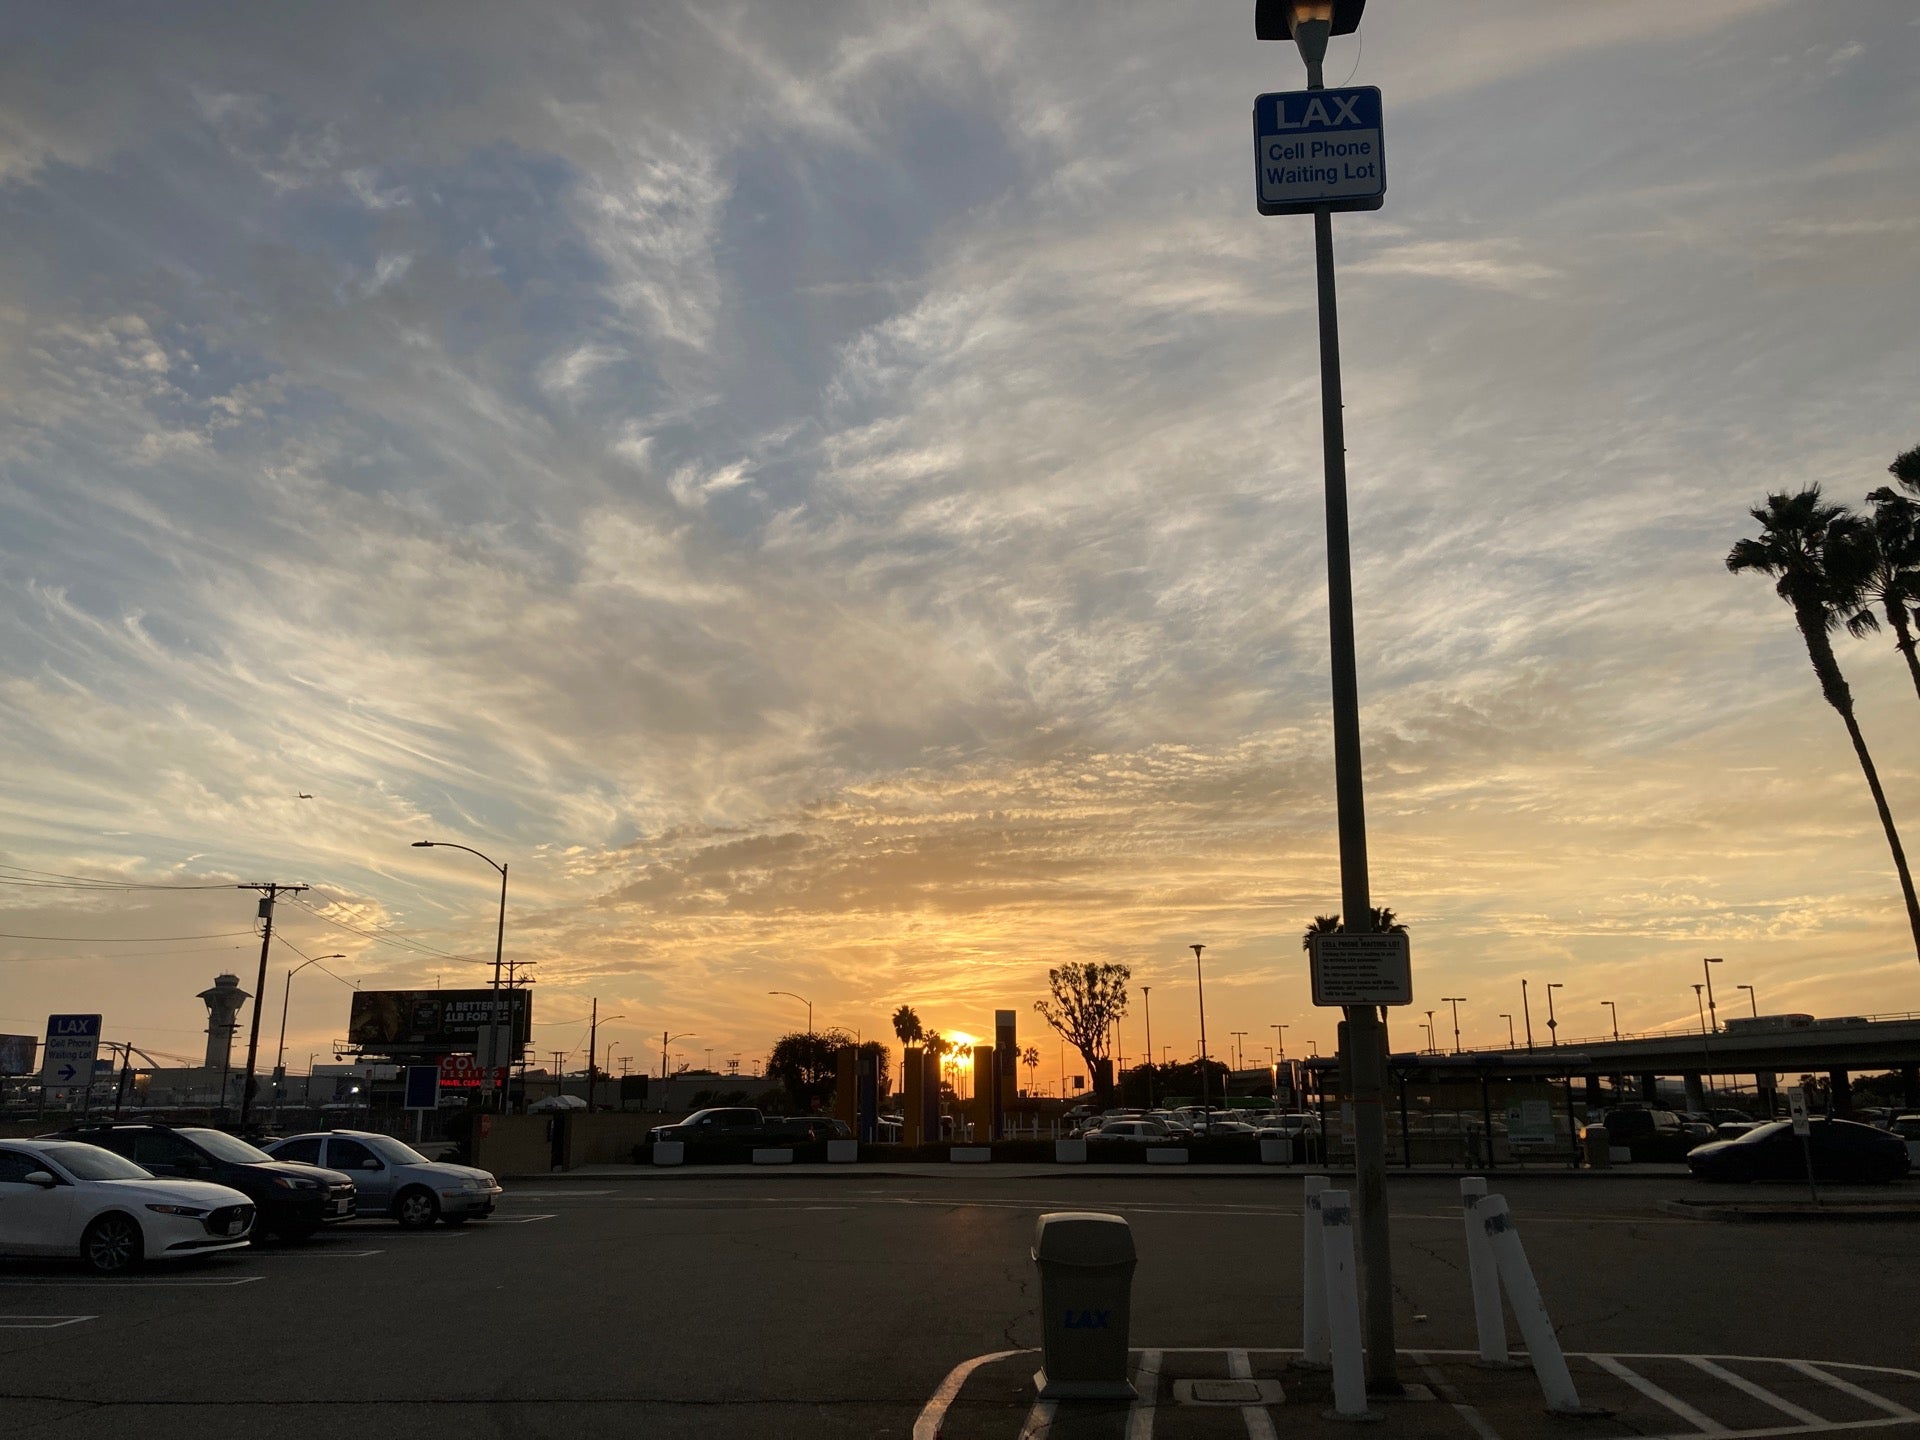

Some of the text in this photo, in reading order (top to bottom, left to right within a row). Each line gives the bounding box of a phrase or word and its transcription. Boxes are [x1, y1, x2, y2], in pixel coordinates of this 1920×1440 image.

[1276, 95, 1362, 129] LAX
[1269, 141, 1371, 160] Cell Phone
[1266, 162, 1375, 185] Waiting Lot
[445, 1001, 453, 1011] A
[455, 1001, 494, 1011] BETTER
[466, 1011, 488, 1021] FOR
[57, 1020, 89, 1033] LAX
[50, 1038, 92, 1047] Cell Phone
[48, 1050, 92, 1061] Waiting Lot
[1064, 1309, 1111, 1328] LAX
